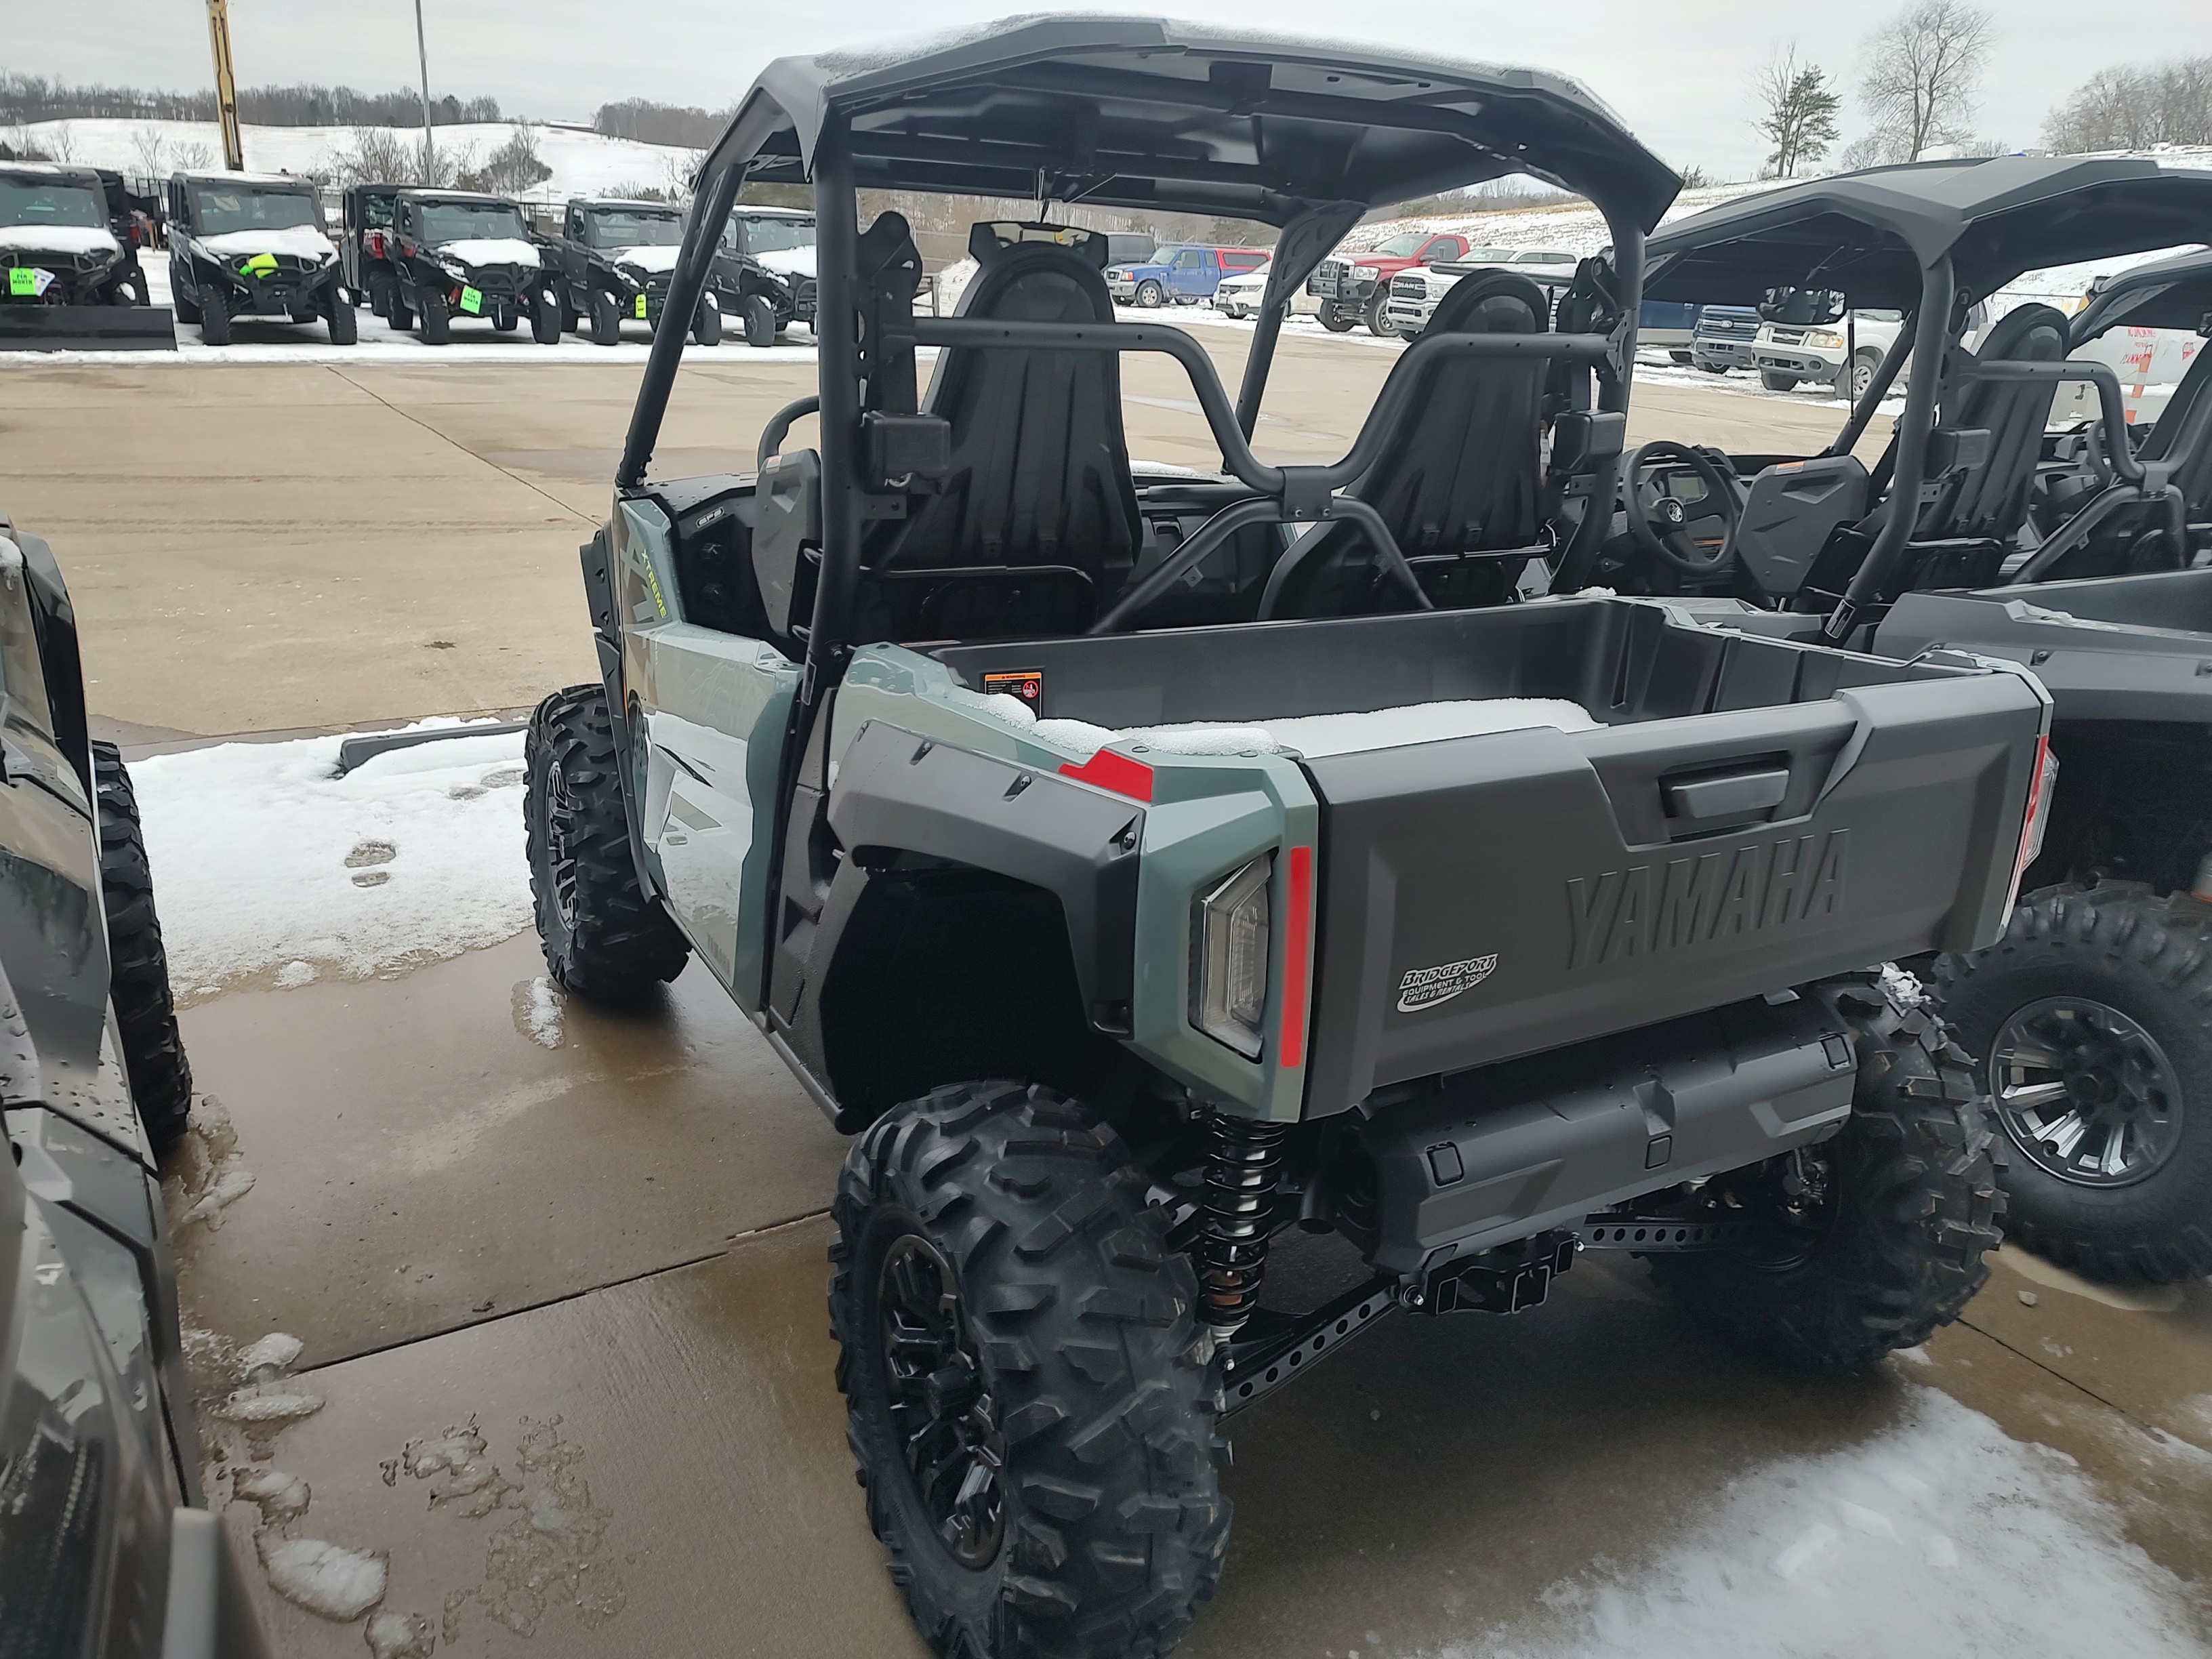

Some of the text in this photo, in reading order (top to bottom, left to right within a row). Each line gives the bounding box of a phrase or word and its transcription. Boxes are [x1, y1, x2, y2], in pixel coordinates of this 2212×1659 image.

[641, 549, 668, 619] XTREME
[1567, 829, 1851, 970] YAMAHA
[1400, 955, 1497, 988] BRIDGEPORT
[1403, 979, 1454, 996] EQUIPMENT
[1465, 972, 1488, 982] TOOL
[1405, 991, 1429, 1004] SALES
[1436, 982, 1471, 997] RENTALS
